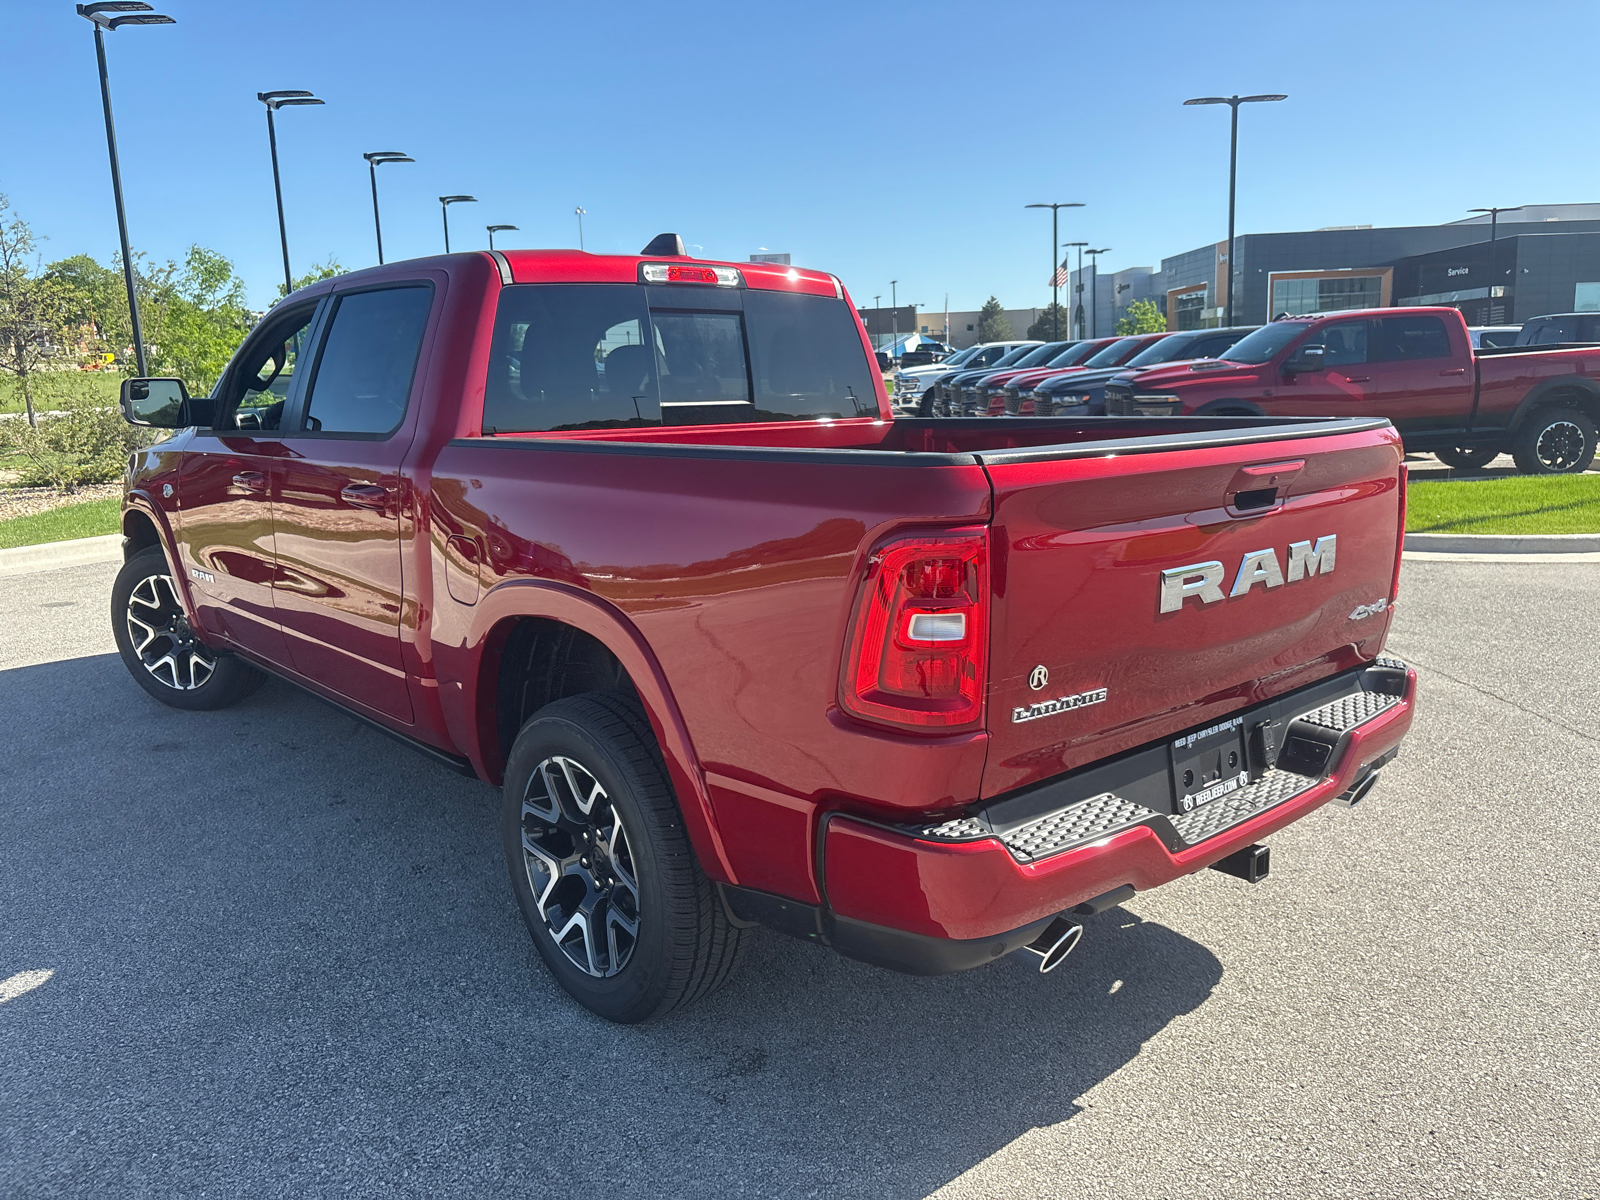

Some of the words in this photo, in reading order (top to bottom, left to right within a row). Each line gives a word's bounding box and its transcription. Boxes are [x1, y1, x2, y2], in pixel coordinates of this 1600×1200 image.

[1447, 266, 1469, 277] Service
[191, 568, 215, 584] RAM
[1159, 533, 1337, 614] RAM
[1012, 688, 1107, 723] LARAMIE
[1175, 737, 1186, 748] REED
[1187, 733, 1197, 743] JEEP
[1198, 725, 1218, 739] CHRYSLER
[1218, 720, 1233, 732] DODGE
[1232, 716, 1243, 726] RAM
[1195, 779, 1238, 806] REEDJEEP.COM
